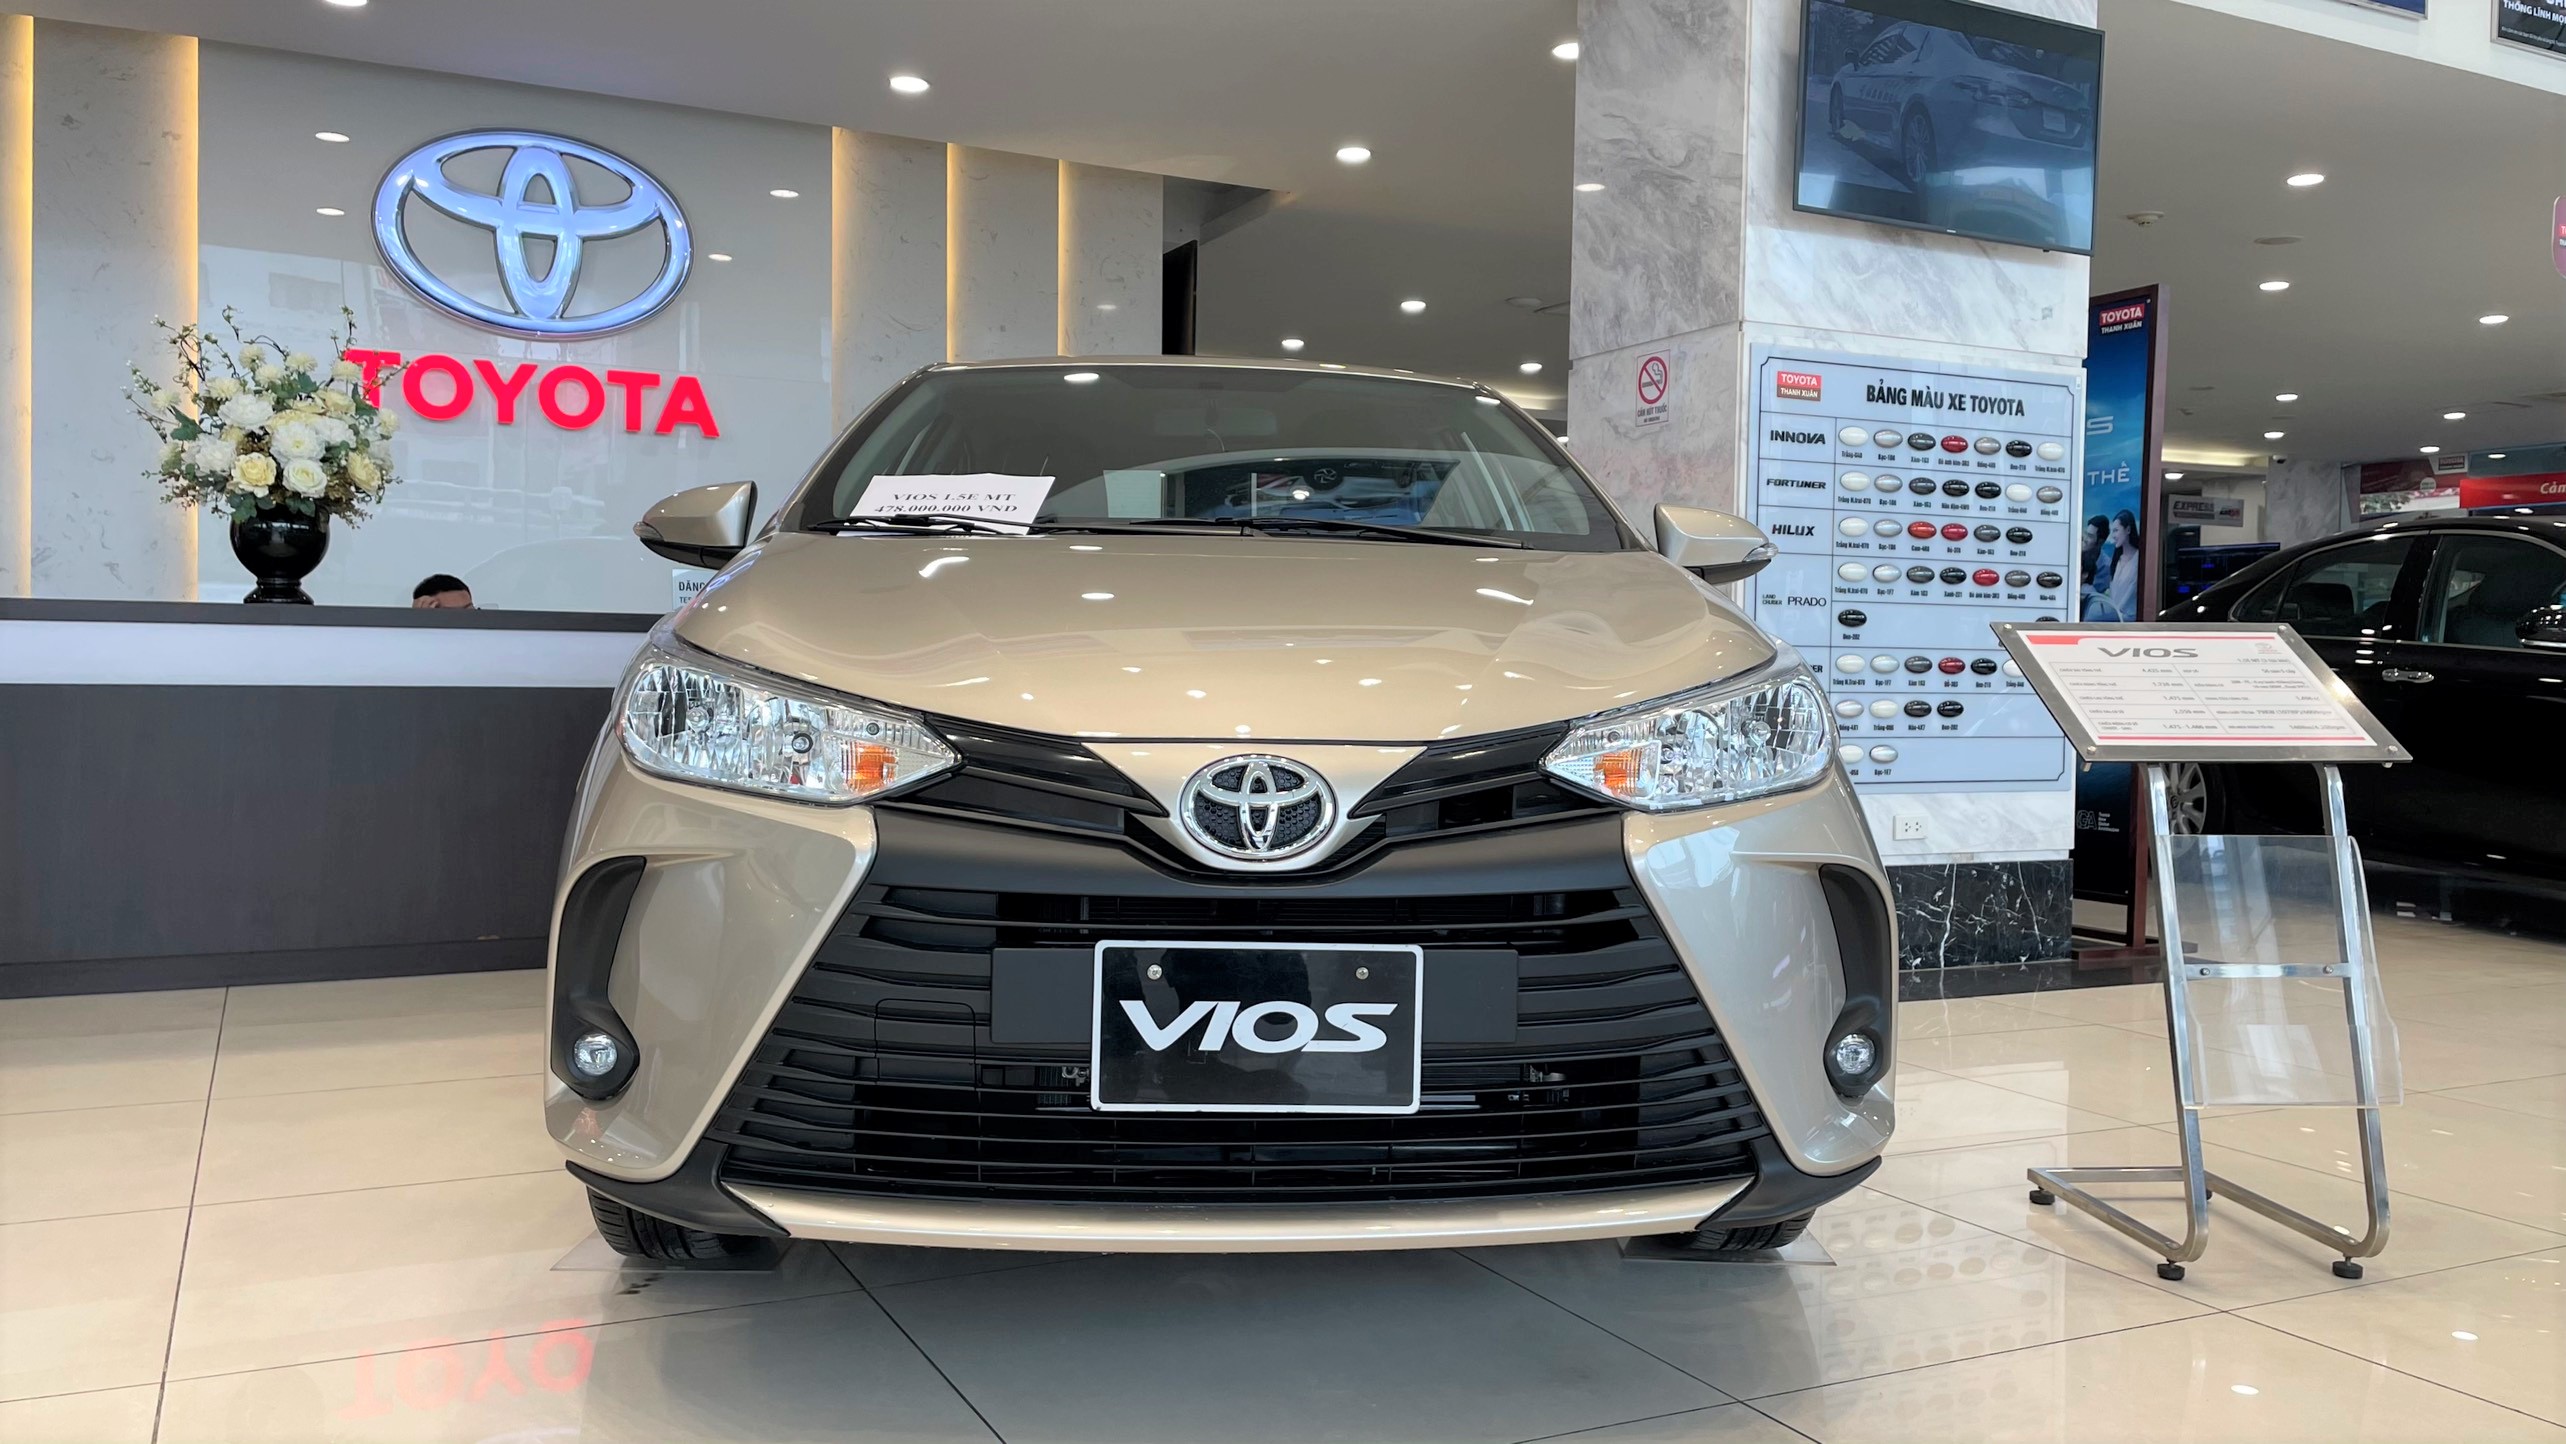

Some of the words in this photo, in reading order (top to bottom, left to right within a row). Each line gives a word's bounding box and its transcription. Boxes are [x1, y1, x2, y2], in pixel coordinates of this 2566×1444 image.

[2101, 307, 2142, 324] TOYOTA
[2101, 324, 2123, 334] THANH
[2124, 320, 2143, 331] XUÂN
[1781, 373, 1818, 386] TOYOTA
[344, 347, 721, 439] TOYOTA
[1780, 387, 1800, 396] THANH
[1866, 378, 1907, 406] BẢNG
[1911, 385, 1944, 409] MÀU
[1948, 393, 1966, 411] XE
[1970, 395, 2025, 417] TOYOTA
[1770, 429, 1826, 445] INNOVA
[1766, 478, 1827, 490] FORTUNER
[894, 493, 938, 501] VIOS
[944, 493, 979, 501] 1.5E
[984, 493, 1016, 501] MT
[874, 505, 971, 513] 478.000.000
[1772, 524, 1815, 537] HILUX
[1787, 596, 1827, 607] PRADO
[2097, 647, 2199, 658] VIOS
[1811, 664, 1823, 673] ER
[1119, 999, 1398, 1054] VIOS
